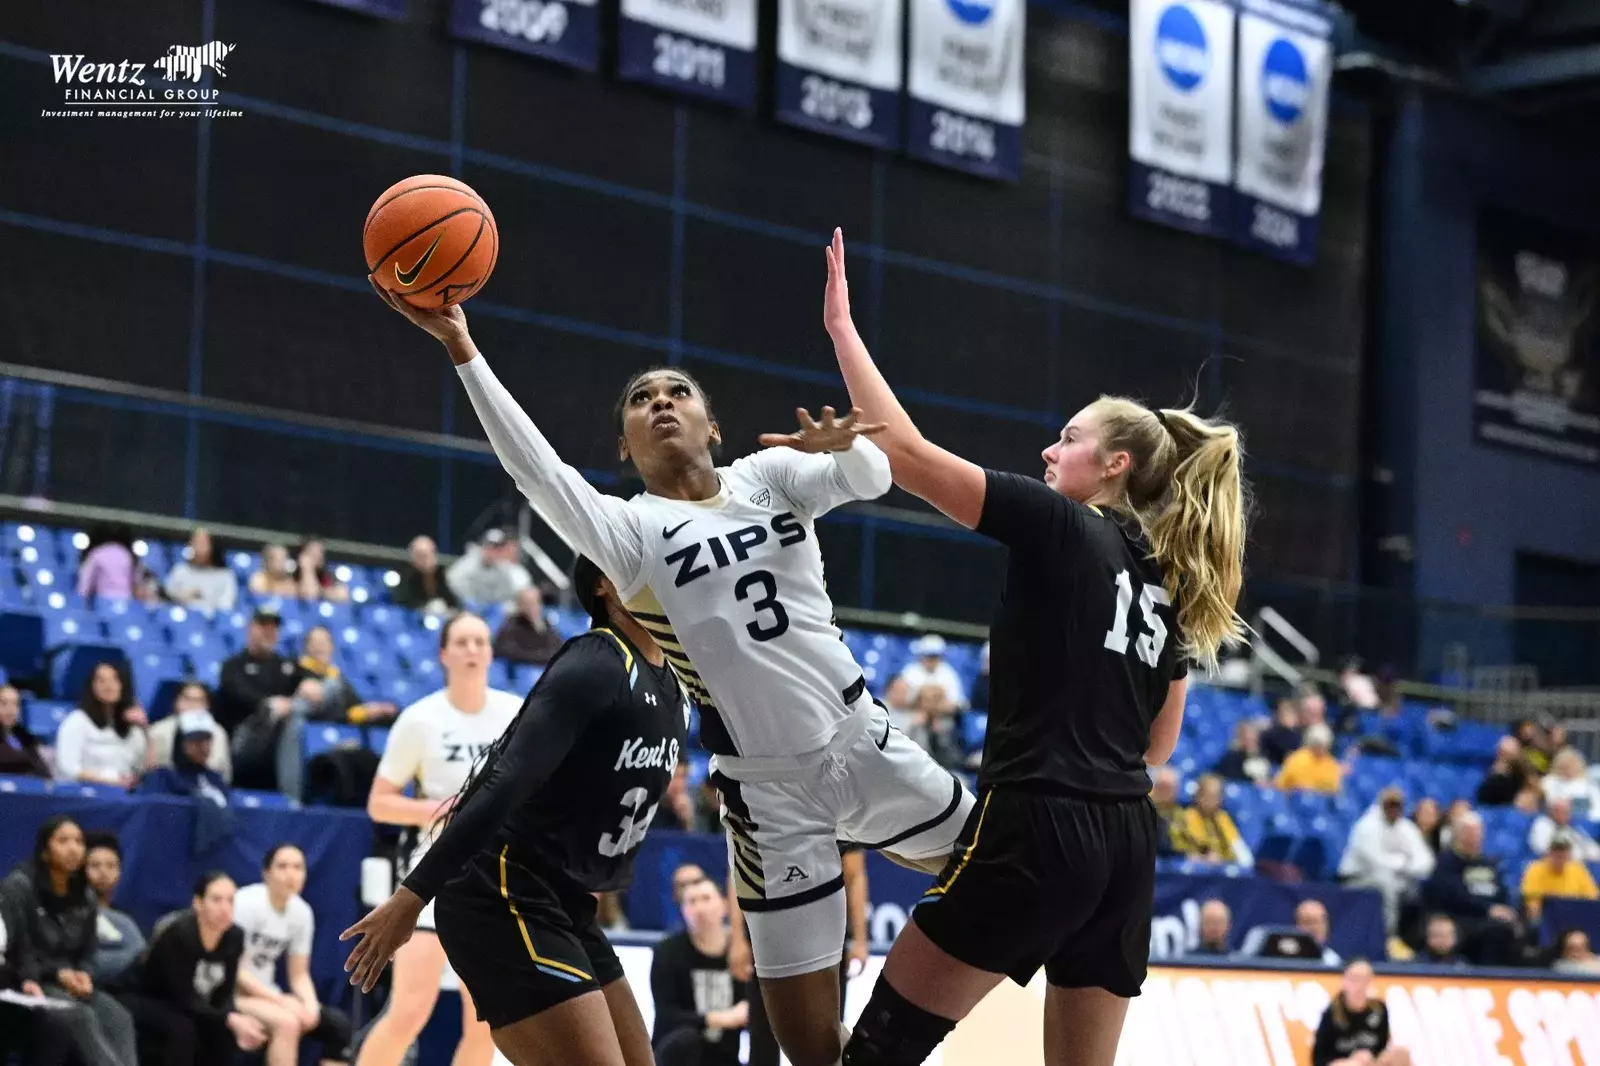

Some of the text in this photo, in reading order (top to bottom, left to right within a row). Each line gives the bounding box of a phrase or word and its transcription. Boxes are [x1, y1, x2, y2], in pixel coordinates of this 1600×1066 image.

[664, 511, 806, 588] ZIPS
[734, 570, 789, 642] 3
[1104, 568, 1171, 668] 15
[614, 737, 664, 771] Kent
[782, 865, 809, 882] A
